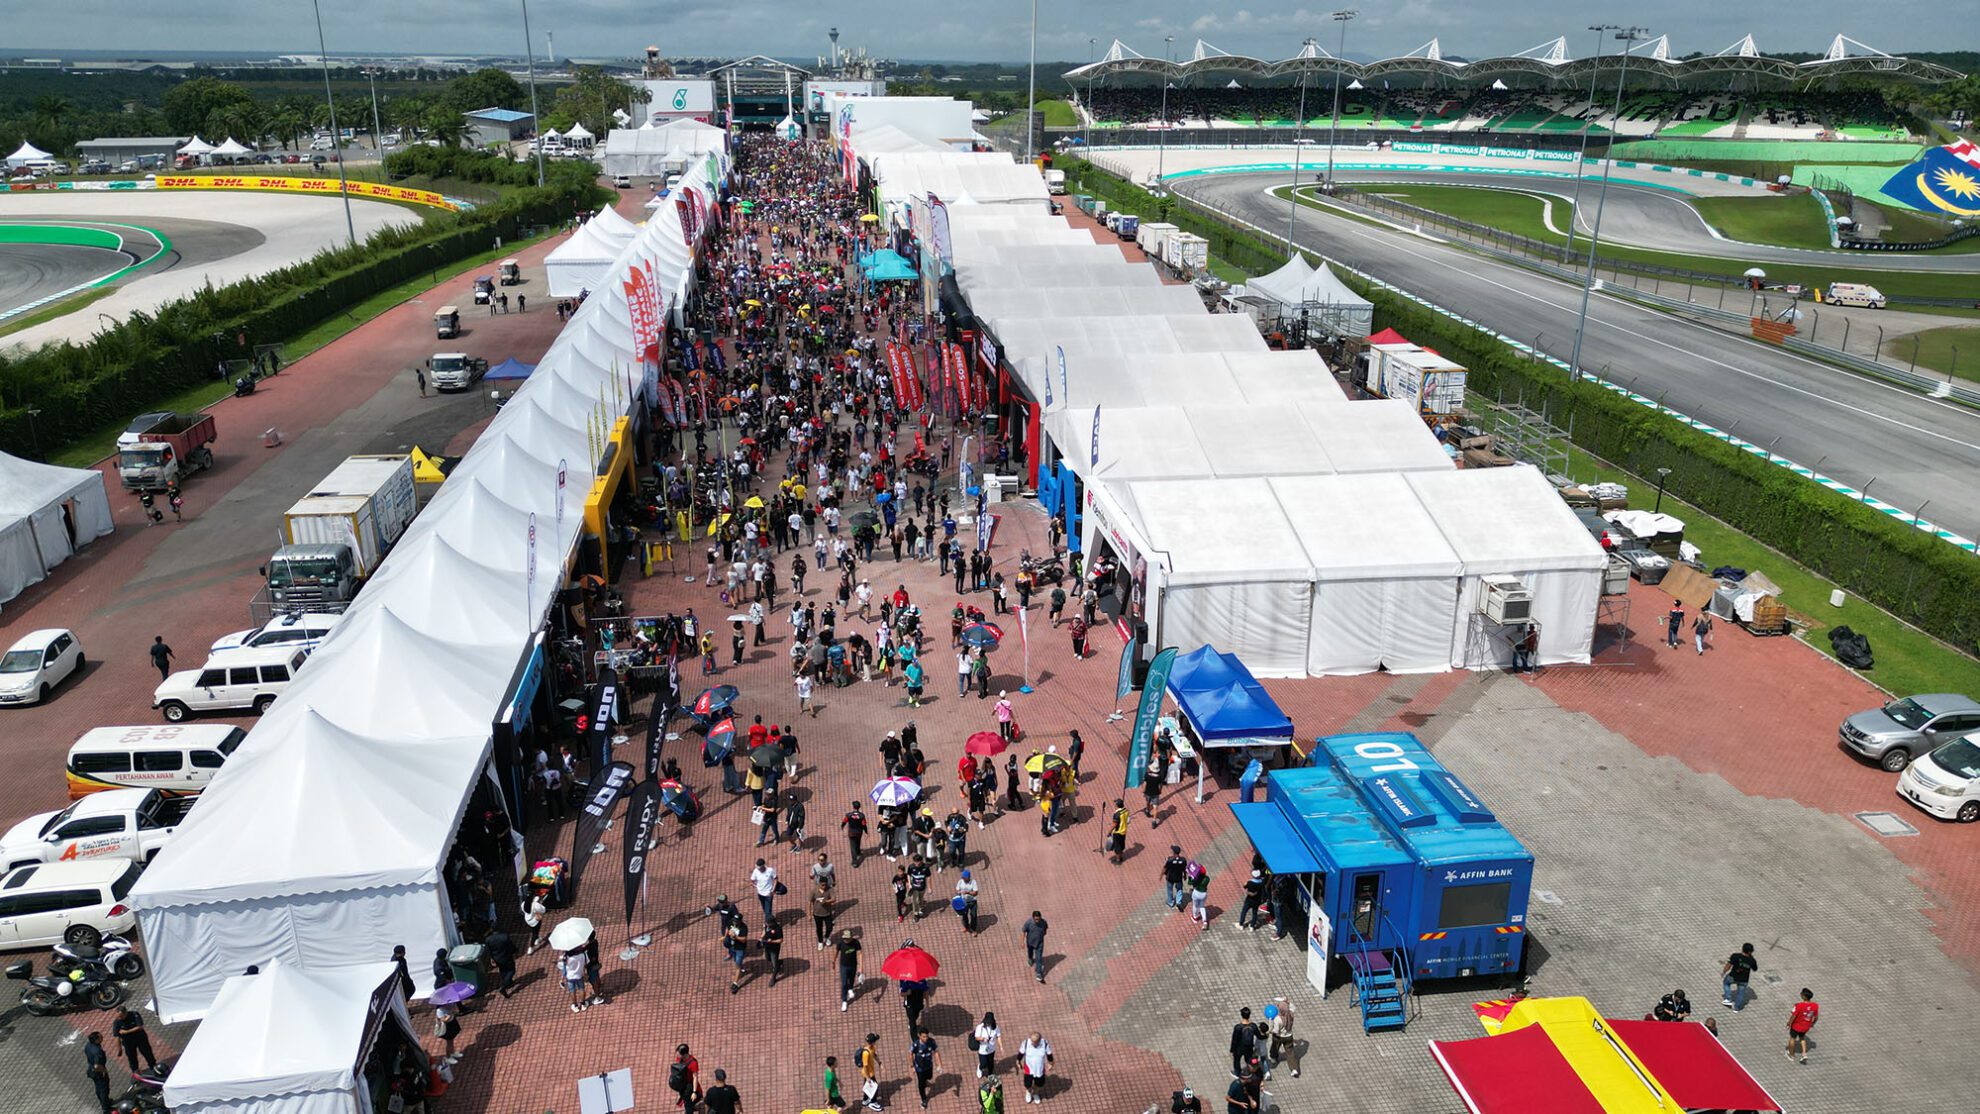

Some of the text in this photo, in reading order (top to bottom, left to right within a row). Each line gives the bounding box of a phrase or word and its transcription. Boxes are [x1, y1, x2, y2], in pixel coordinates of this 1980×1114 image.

[1393, 142, 1432, 152] PETRONAS
[1441, 145, 1479, 154] PETRONAS
[1487, 148, 1526, 158] PETRONAS
[1534, 151, 1573, 160] PETRONAS
[164, 178, 197, 186] DHL
[213, 178, 244, 186] DHL
[259, 179, 288, 188] DHL
[302, 181, 327, 189] DHL
[372, 186, 392, 196] DHL
[401, 190, 419, 200] DHL
[889, 348, 901, 377] ENEOS
[901, 351, 914, 380] ENEOS
[954, 351, 966, 380] ENEOS
[1133, 690, 1160, 769] Bubbles
[1353, 742, 1420, 772] 01
[115, 773, 155, 781] PERTAHANAN
[1380, 786, 1413, 817] AFFIN ISLAMIC
[634, 795, 654, 851] RUDY
[1460, 869, 1513, 880] AFFIN BANK
